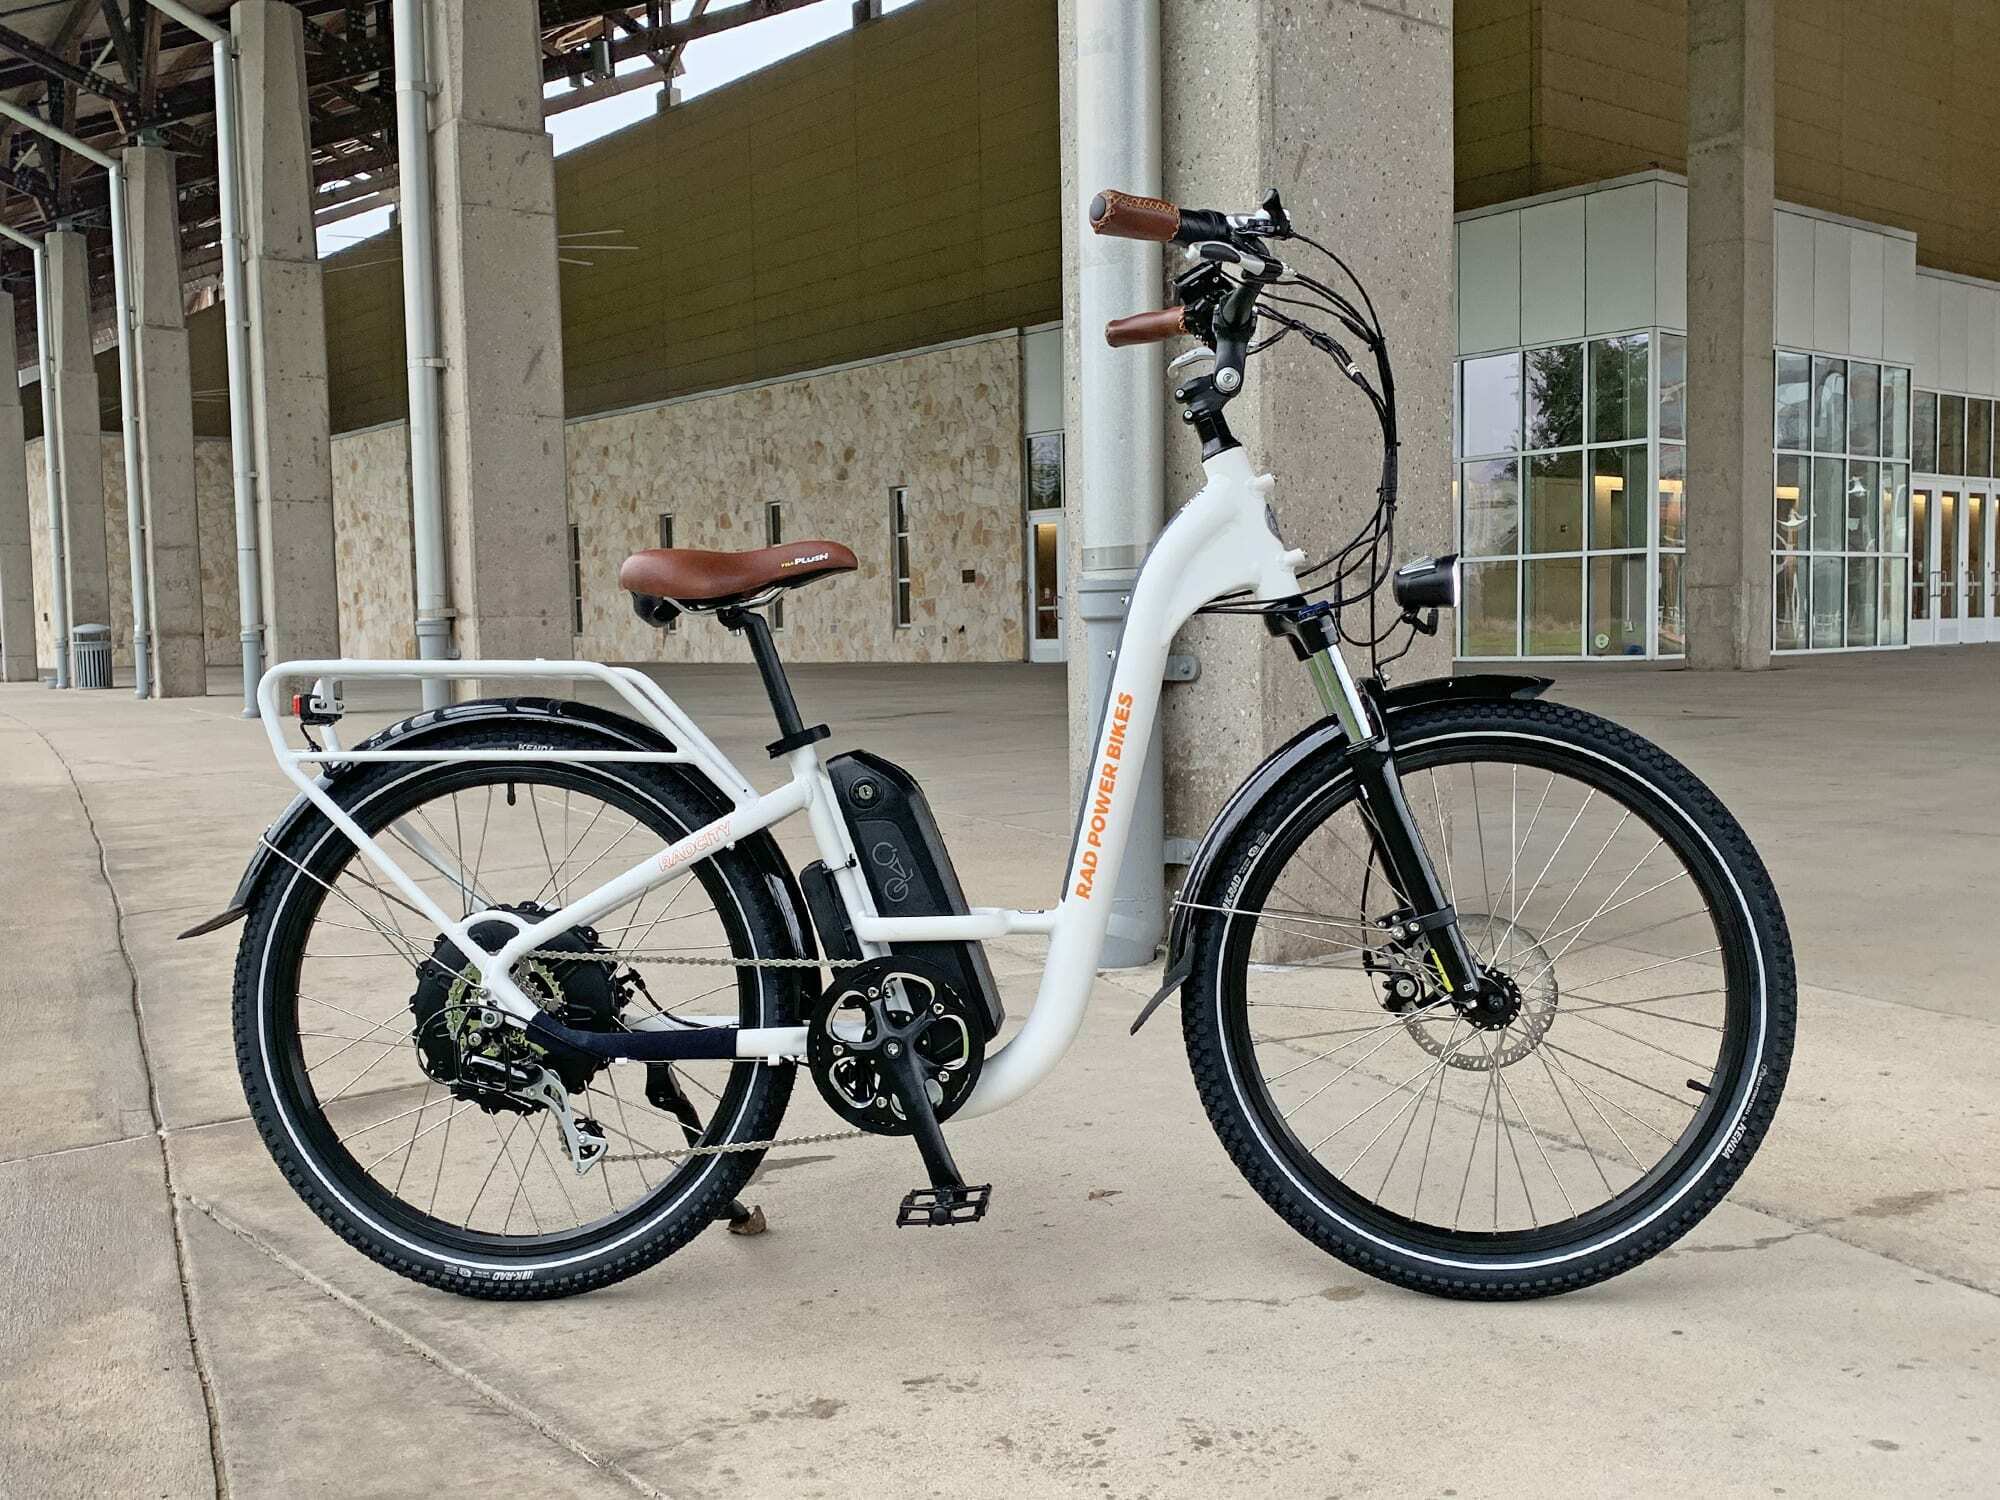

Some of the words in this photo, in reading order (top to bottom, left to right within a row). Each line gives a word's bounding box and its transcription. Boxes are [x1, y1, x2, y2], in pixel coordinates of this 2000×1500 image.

[794, 552, 829, 565] PLUSH
[1075, 850, 1098, 901] RAD
[1087, 762, 1119, 848] POWER
[1106, 692, 1133, 760] BIKES
[657, 820, 731, 872] RADCITY
[1721, 1120, 1747, 1160] KENDA
